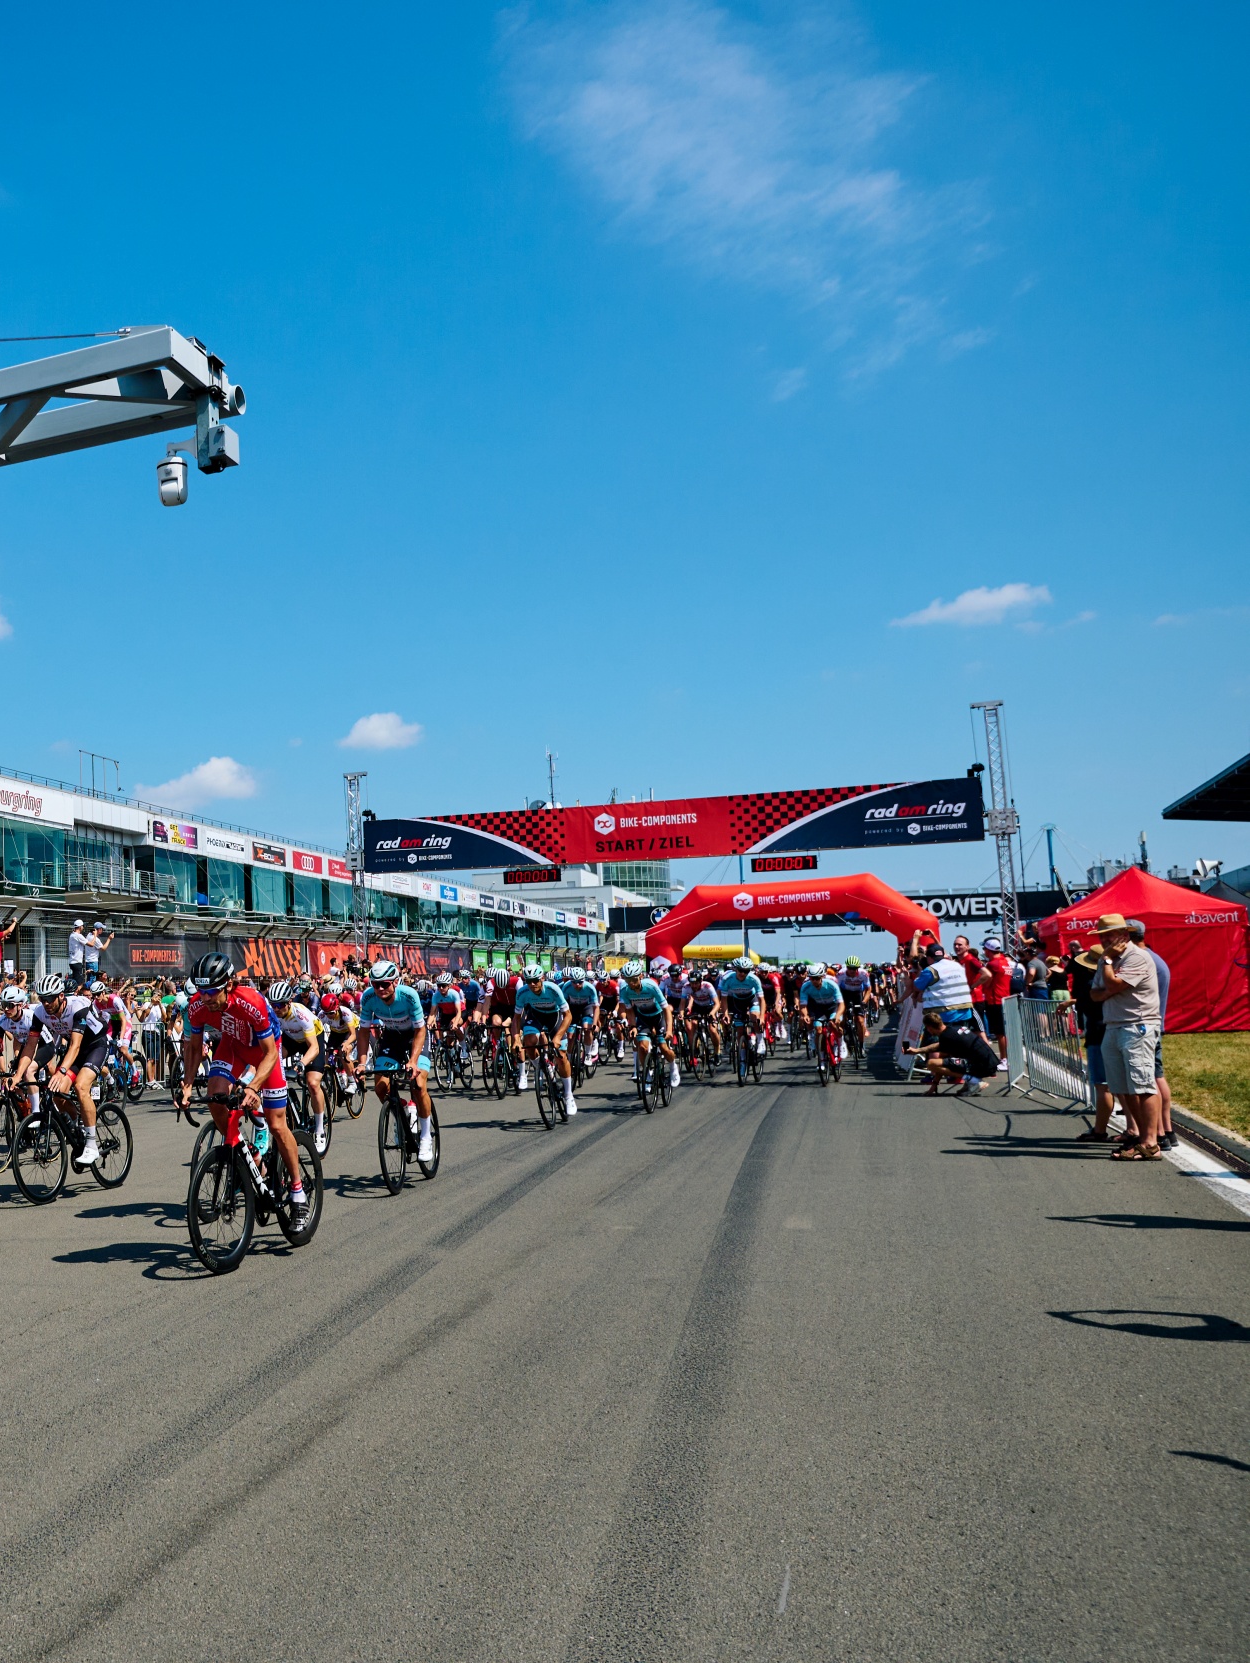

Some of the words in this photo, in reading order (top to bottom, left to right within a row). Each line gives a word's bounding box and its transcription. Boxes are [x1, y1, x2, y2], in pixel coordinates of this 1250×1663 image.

[864, 804, 899, 818] rad
[897, 805, 927, 816] am
[926, 800, 966, 817] ring
[619, 813, 697, 828] BIKE-COMPONENTS
[922, 822, 967, 832] BIKE-COMPONENTS
[375, 836, 402, 850] rad
[400, 838, 422, 848] am
[422, 834, 452, 849] ring
[595, 838, 645, 853] START
[658, 836, 695, 850] ZIEL
[755, 856, 813, 871] 00:00:07
[507, 869, 556, 883] 00:00:07
[757, 891, 831, 906] BIKE-COMPONENTS
[1066, 917, 1099, 931] abav
[1184, 911, 1240, 925] abavent
